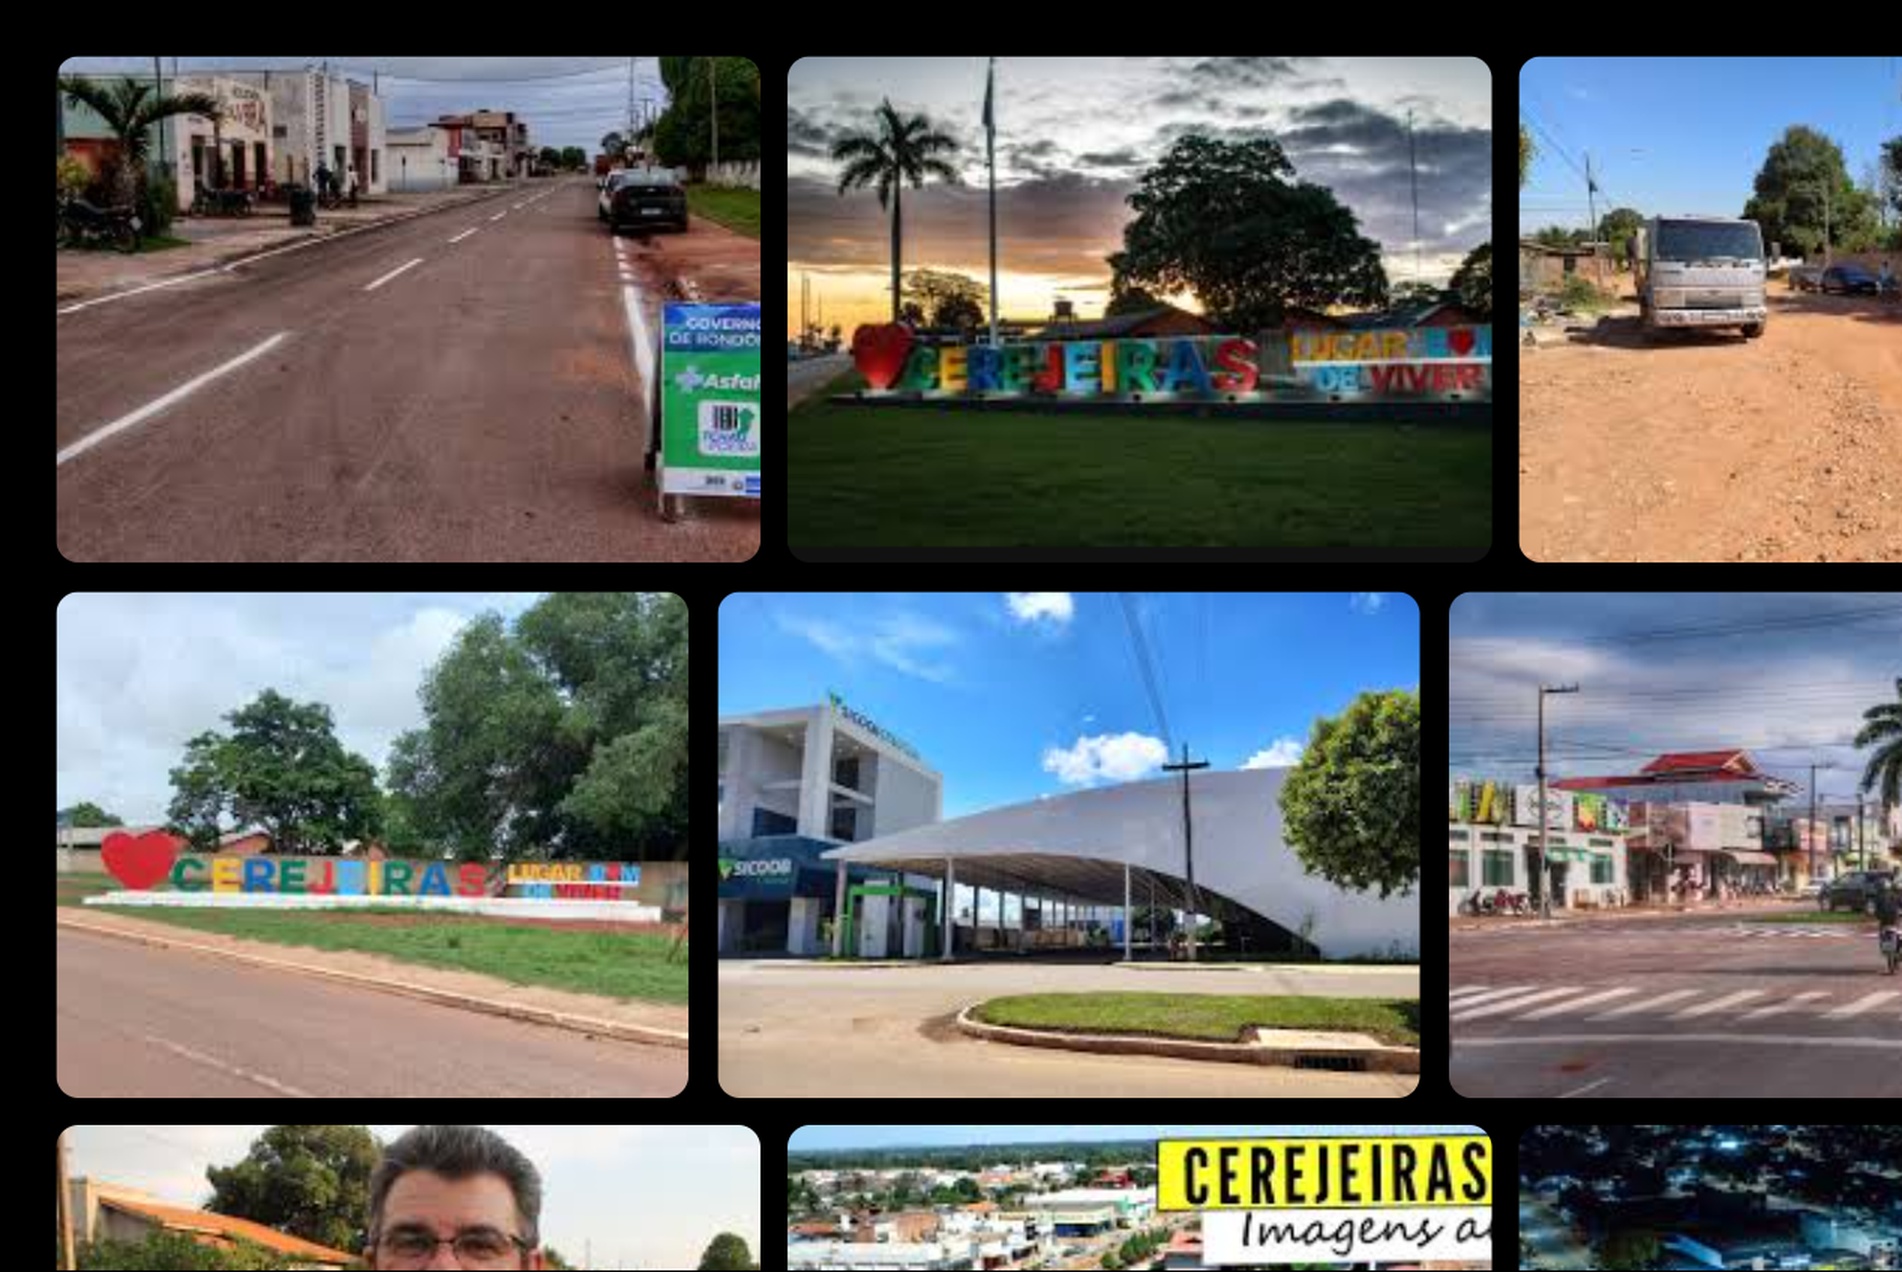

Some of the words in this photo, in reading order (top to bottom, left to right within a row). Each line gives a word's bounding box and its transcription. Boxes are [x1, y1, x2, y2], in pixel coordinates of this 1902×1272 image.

[669, 332, 692, 344] DE
[907, 339, 1259, 392] CEREJEIRAS
[1370, 363, 1483, 392] VIVER
[170, 857, 487, 897] CEREJEIRAS
